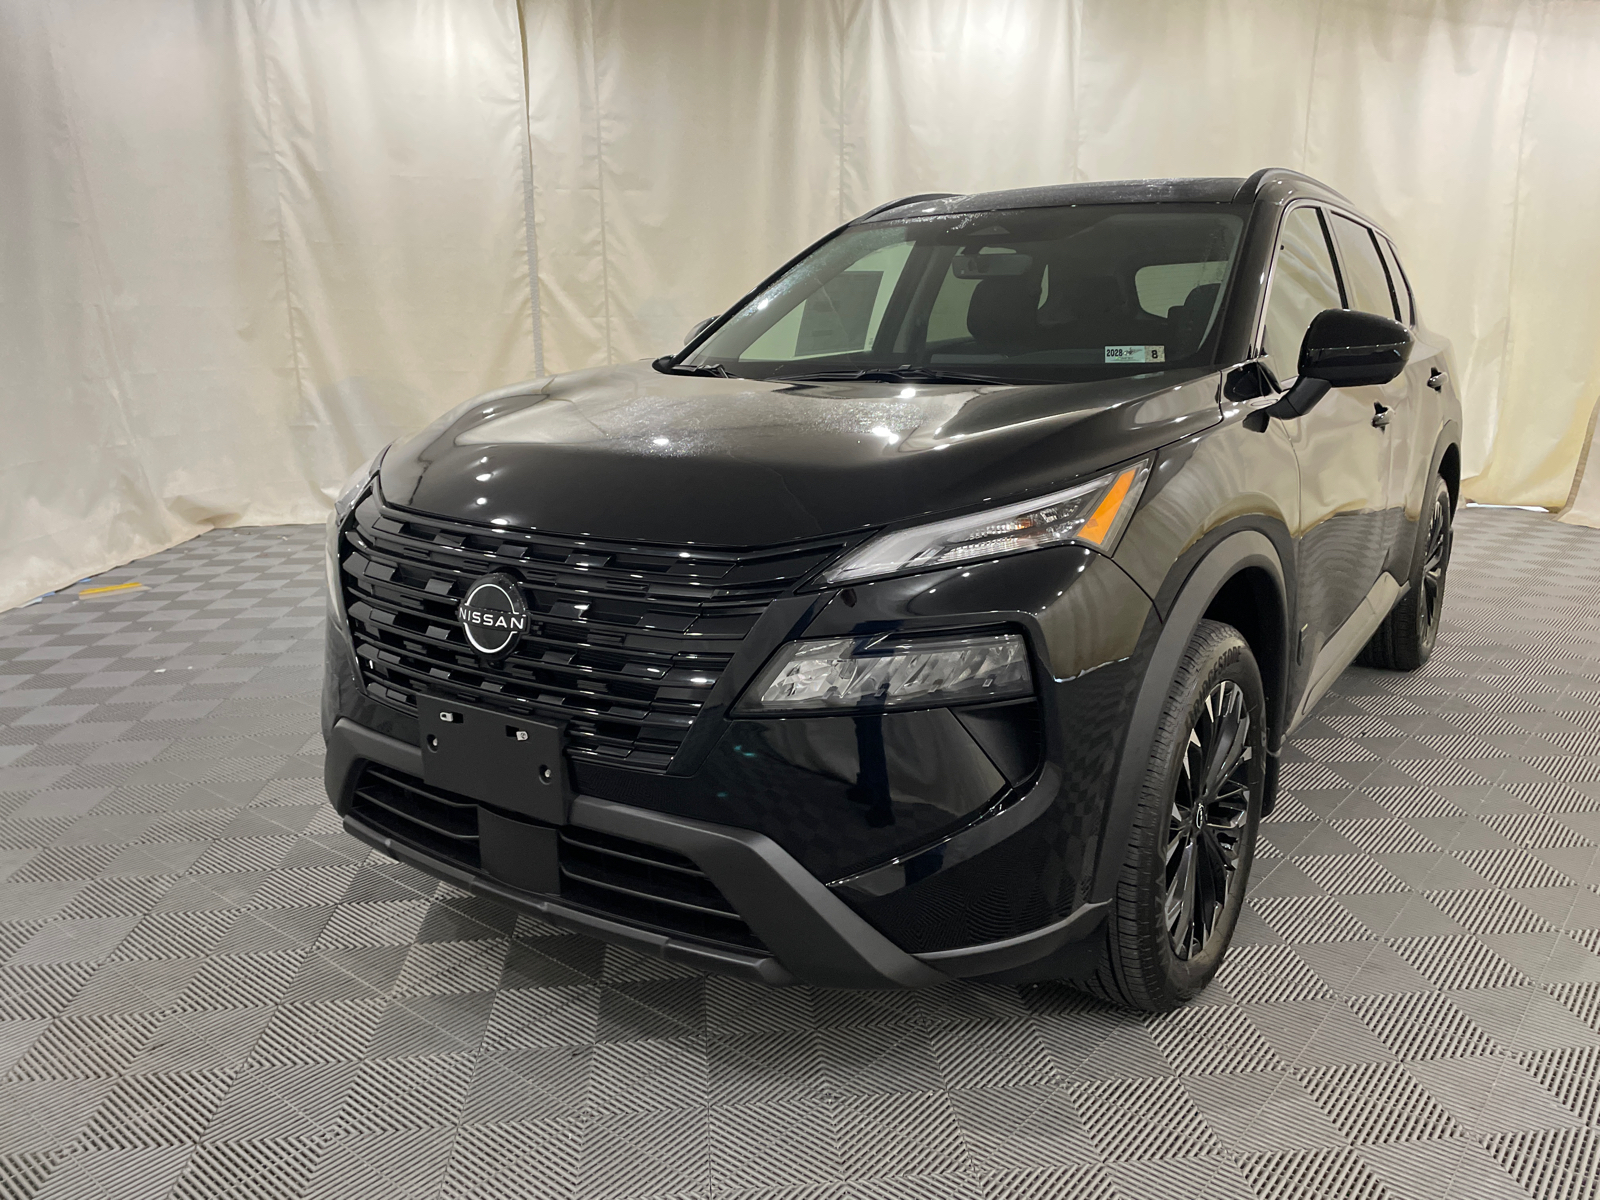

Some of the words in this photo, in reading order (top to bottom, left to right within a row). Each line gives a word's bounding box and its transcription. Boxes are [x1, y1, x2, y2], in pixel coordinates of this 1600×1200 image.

[1106, 349, 1123, 357] 2028
[1151, 350, 1159, 359] 8
[459, 607, 524, 630] NISSAN
